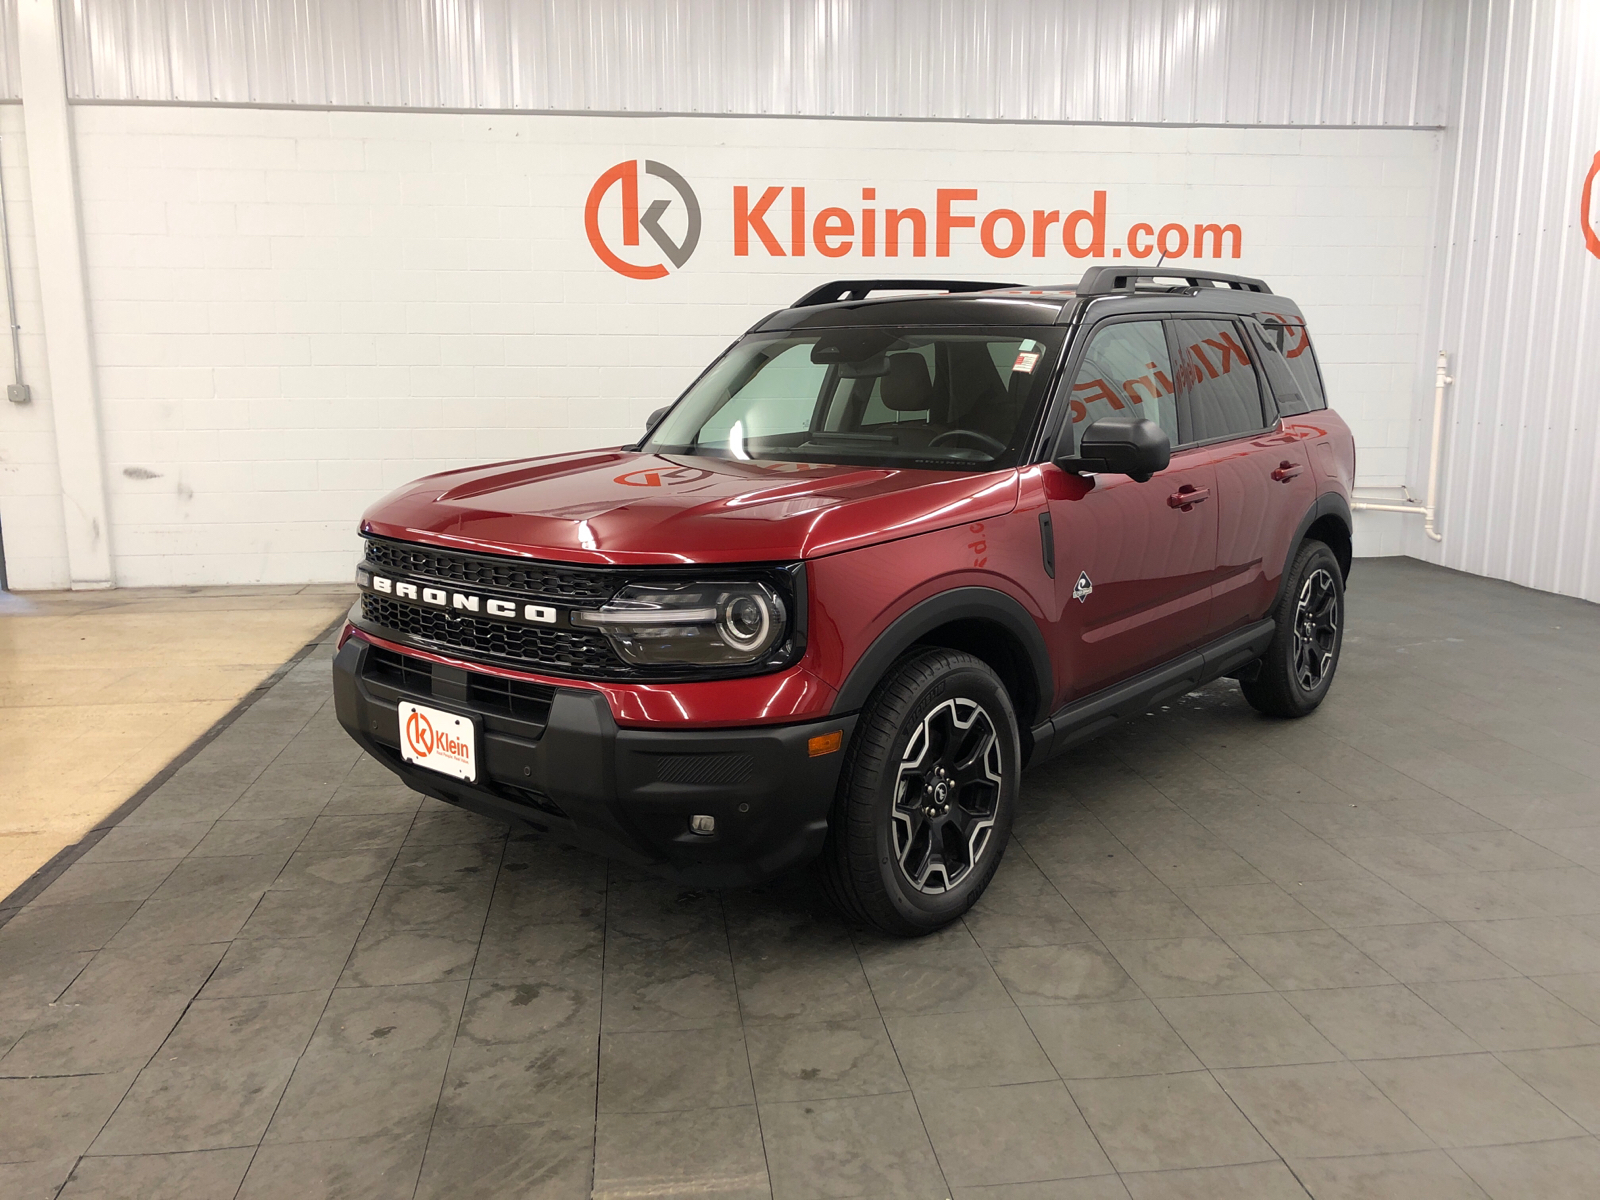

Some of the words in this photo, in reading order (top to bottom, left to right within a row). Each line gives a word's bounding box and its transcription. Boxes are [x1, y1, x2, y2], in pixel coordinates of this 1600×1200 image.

[733, 186, 1242, 259] KleinFord.com
[373, 576, 557, 624] BRONCO
[436, 730, 469, 759] Klein
